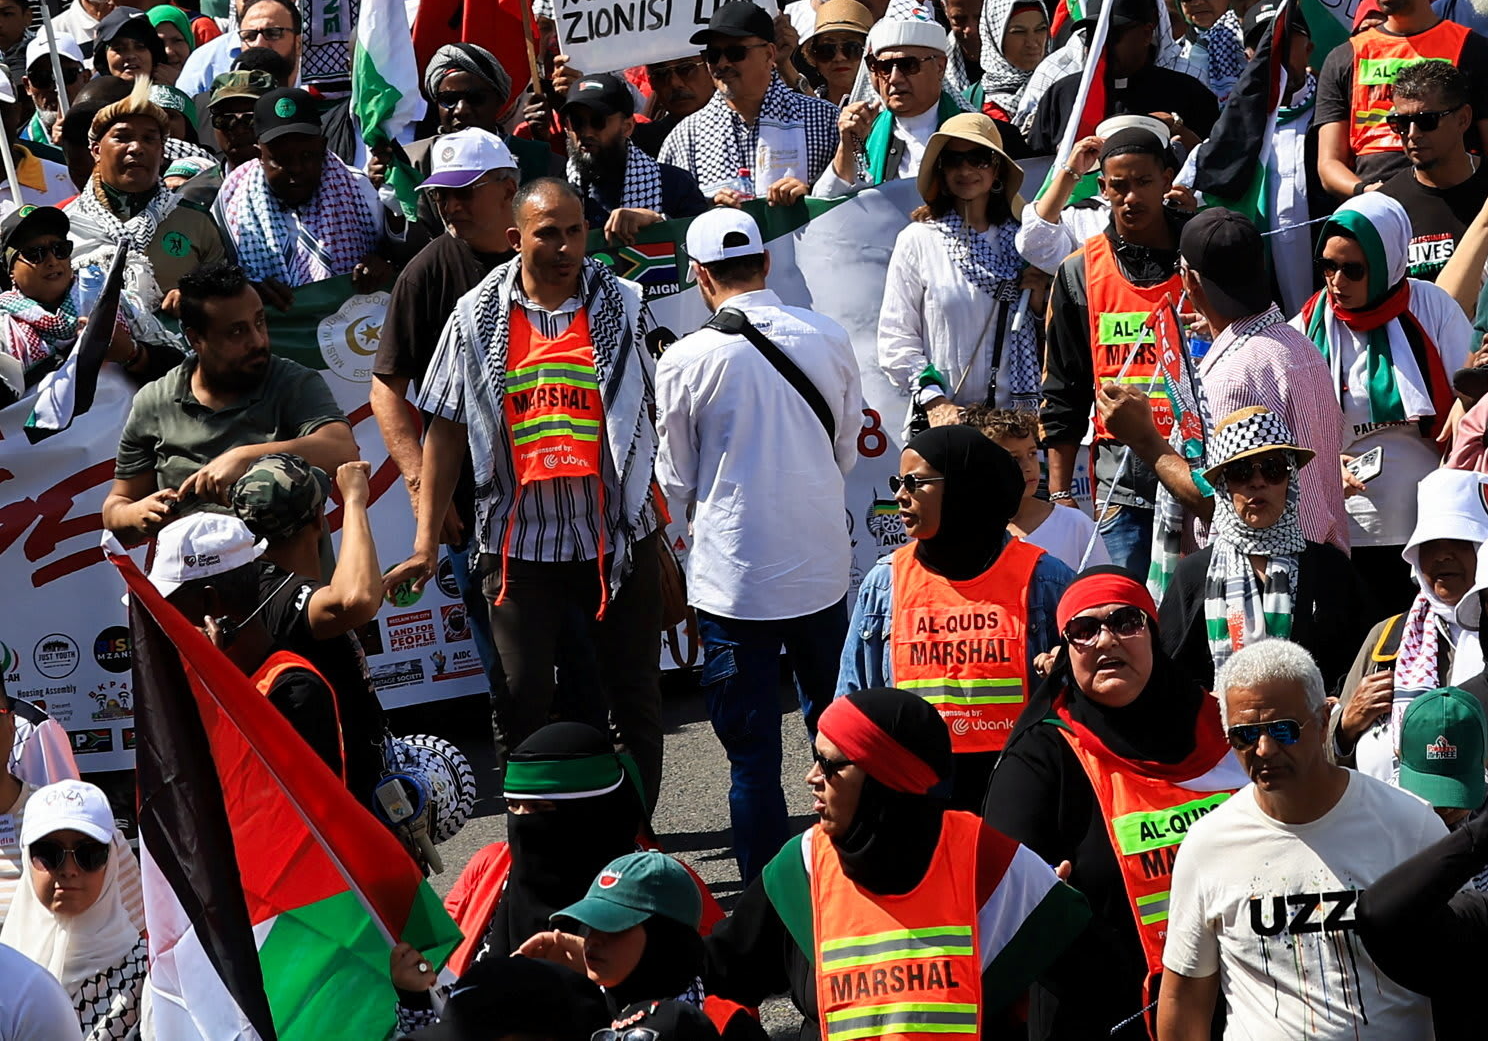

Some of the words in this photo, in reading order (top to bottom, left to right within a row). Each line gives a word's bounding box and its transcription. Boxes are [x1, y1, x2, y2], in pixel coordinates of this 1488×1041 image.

[1407, 240, 1454, 263] LIVES
[648, 283, 681, 295] AIGN
[1106, 345, 1157, 366] MARS
[512, 386, 591, 415] MARSHAL
[883, 532, 907, 546] ANC
[388, 626, 413, 637] LAND
[415, 623, 434, 632] FOR
[916, 611, 998, 635] AL-QUDS
[390, 632, 436, 648] PEOPLE
[38, 653, 54, 662] JUST
[56, 650, 76, 660] YOUTH
[97, 651, 133, 661] MZANS
[452, 650, 472, 660] AIDC
[910, 639, 1011, 666] MARSHAL
[372, 678, 396, 687] ERITAGE
[396, 672, 422, 682] SOCIETY
[17, 688, 45, 699] Housing
[45, 684, 77, 696] Assembly
[972, 718, 1014, 731] ubank
[830, 960, 959, 1003] MARSHAL
